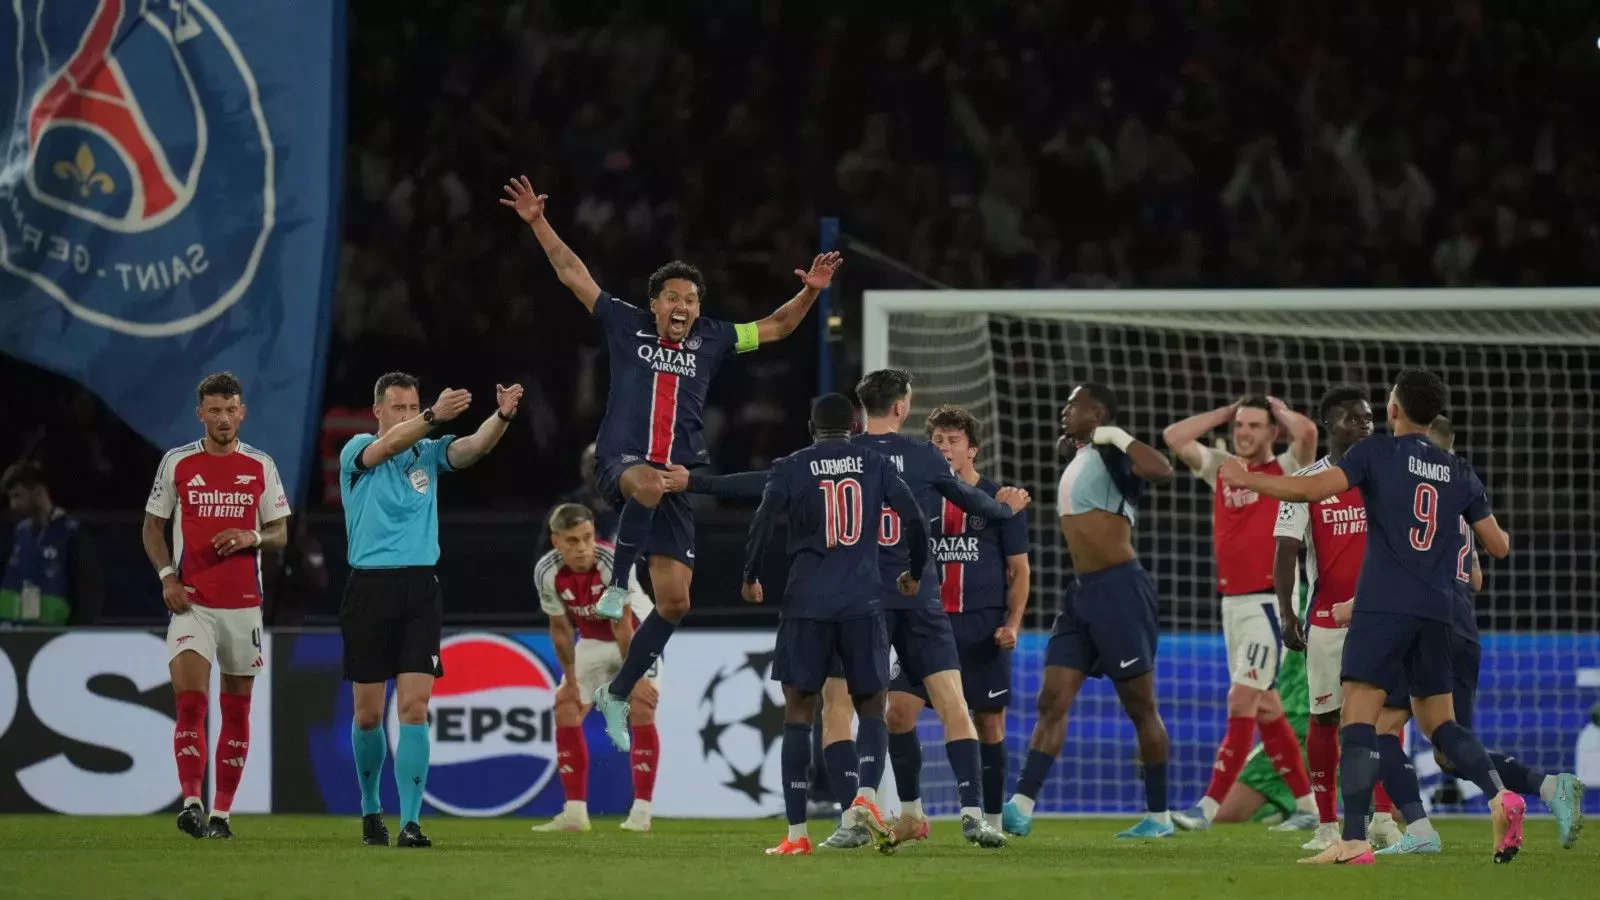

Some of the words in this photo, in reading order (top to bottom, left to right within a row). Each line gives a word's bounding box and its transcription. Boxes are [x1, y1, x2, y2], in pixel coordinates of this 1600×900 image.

[637, 344, 697, 368] QATAR
[651, 361, 696, 378] AIRWAYS
[1408, 455, 1450, 483] G.RAMOS
[187, 490, 255, 505] Emirates
[198, 505, 213, 518] FLY
[214, 505, 245, 518] BETTER
[819, 478, 862, 549] 10
[1321, 505, 1367, 524] Emira
[1409, 483, 1438, 551] 9
[1333, 522, 1348, 536] FLY
[1349, 520, 1368, 534] BET
[929, 537, 979, 554] QATAR
[937, 551, 979, 562] AIRWAYS
[252, 627, 262, 653] 4
[1246, 642, 1269, 669] 41
[427, 706, 553, 743] EPSI
[175, 730, 198, 740] AFC
[227, 739, 248, 749] AFC
